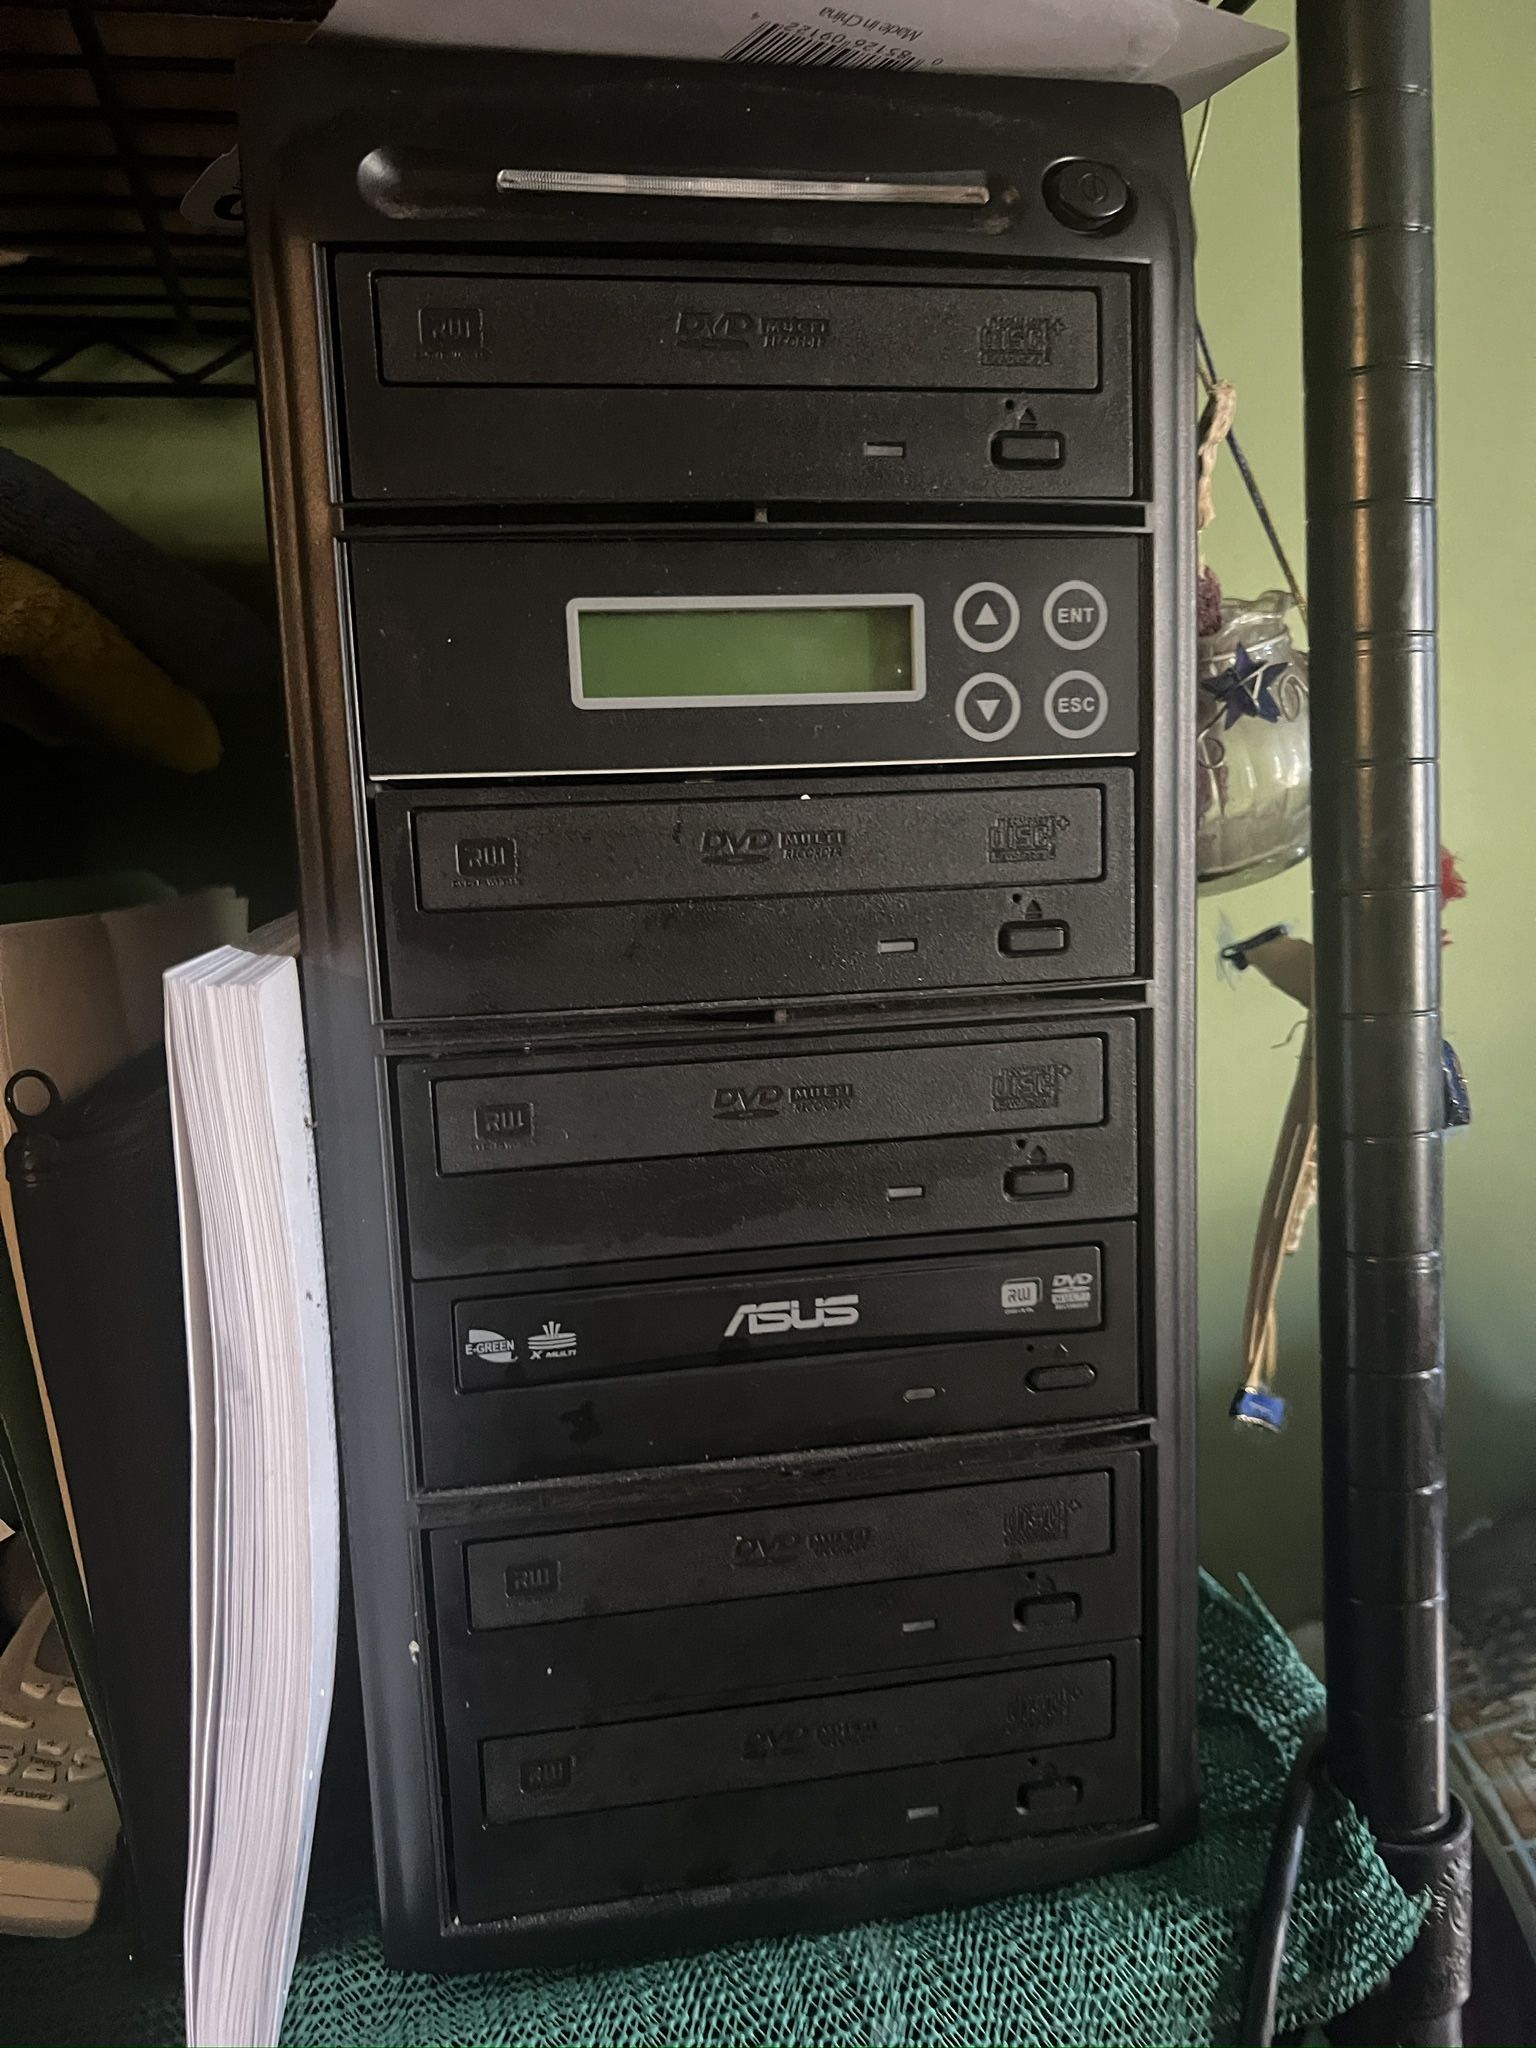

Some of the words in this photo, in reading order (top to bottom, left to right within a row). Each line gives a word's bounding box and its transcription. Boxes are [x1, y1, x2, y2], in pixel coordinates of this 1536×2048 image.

[819, 6, 863, 27] China
[865, 18, 878, 30] in
[784, 21, 847, 43] 09122
[878, 23, 923, 42] Made
[853, 38, 912, 59] 85126
[675, 311, 752, 336] DVD
[1058, 608, 1094, 624] ENT
[1058, 697, 1095, 713] ESC
[700, 830, 773, 855] DVD
[781, 831, 844, 846] MULTI
[464, 846, 505, 868] RW
[712, 1086, 783, 1110] DVD
[793, 1084, 852, 1101] MULTI
[485, 1110, 525, 1131] RW
[1052, 1273, 1093, 1287] DVD
[1008, 1288, 1031, 1303] RW
[724, 1295, 859, 1337] ASUS
[465, 1340, 515, 1355] E-GREEN
[529, 1350, 543, 1360] X
[546, 1349, 577, 1358] MULTI
[514, 1568, 550, 1589] RW
[6, 1786, 55, 1801] Power
